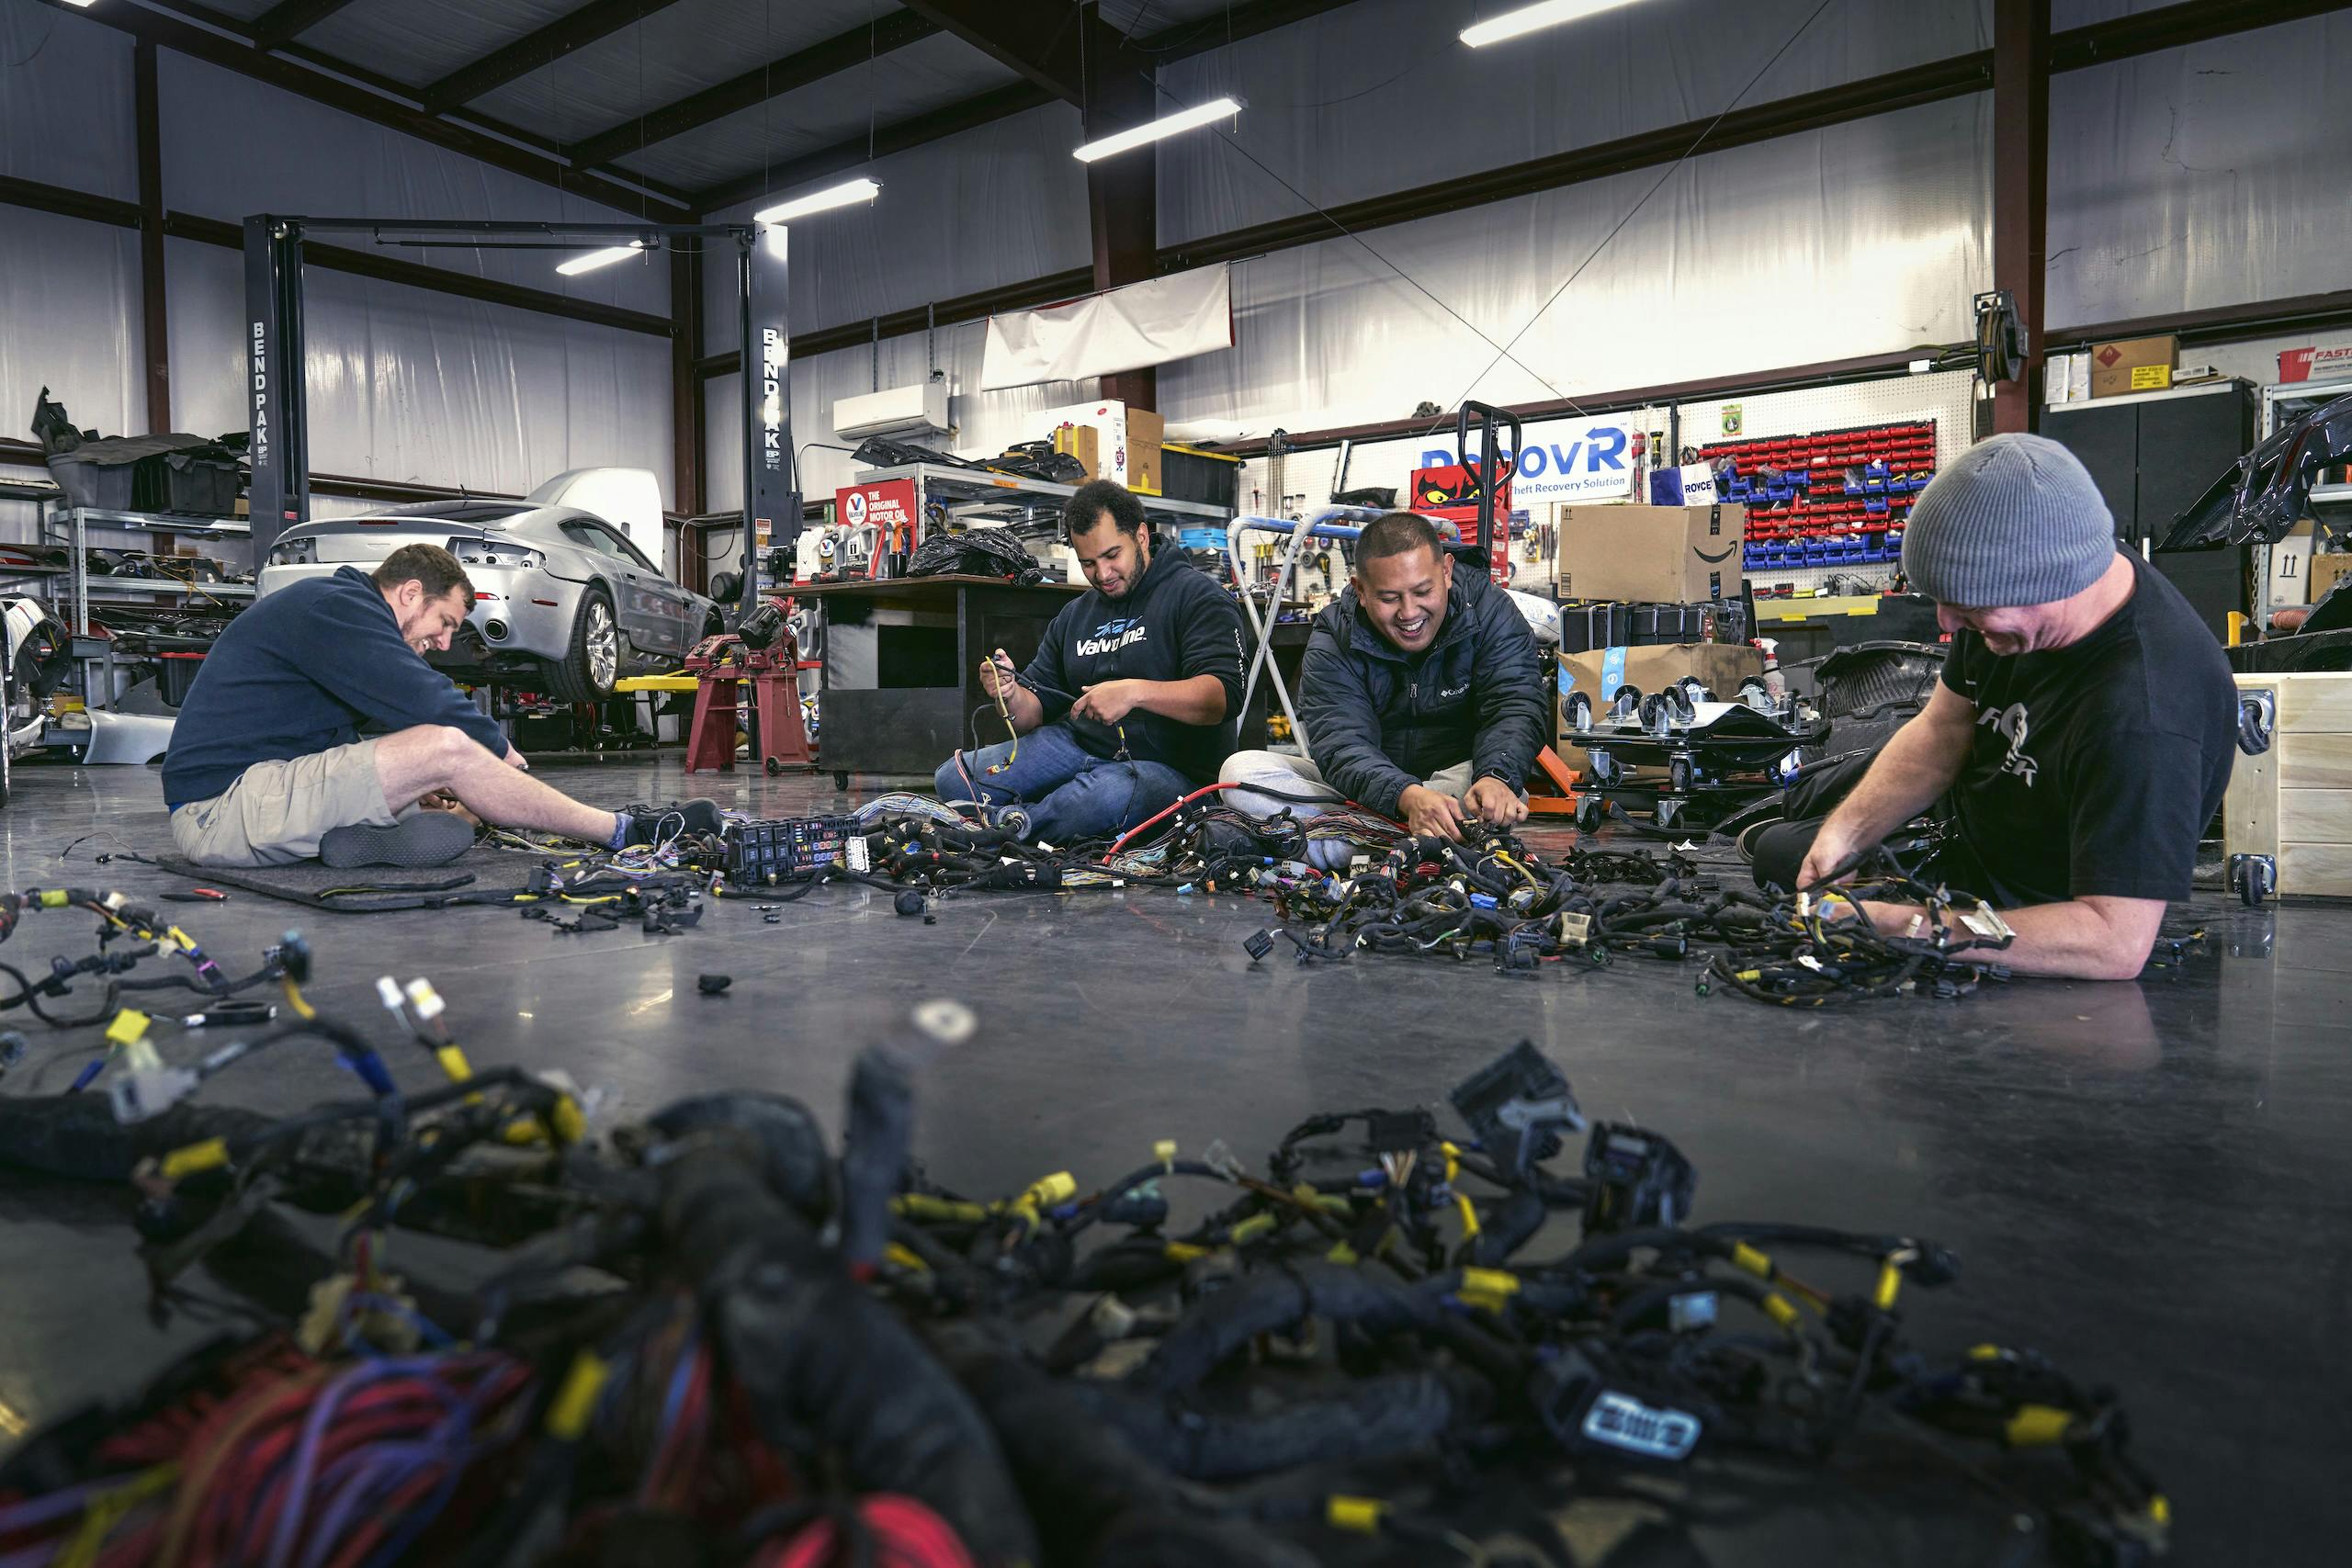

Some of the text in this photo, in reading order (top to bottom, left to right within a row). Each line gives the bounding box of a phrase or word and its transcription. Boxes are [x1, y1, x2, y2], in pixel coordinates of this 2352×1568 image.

[2315, 348, 2352, 360] FAST
[254, 321, 267, 445] BENDPAK
[763, 328, 780, 449] BNDK
[1535, 481, 1583, 493] Recovery
[1584, 477, 1625, 489] Solution
[868, 491, 880, 502] THE
[869, 499, 899, 512] ORIGINAL
[870, 509, 907, 523] MOTOR OIL
